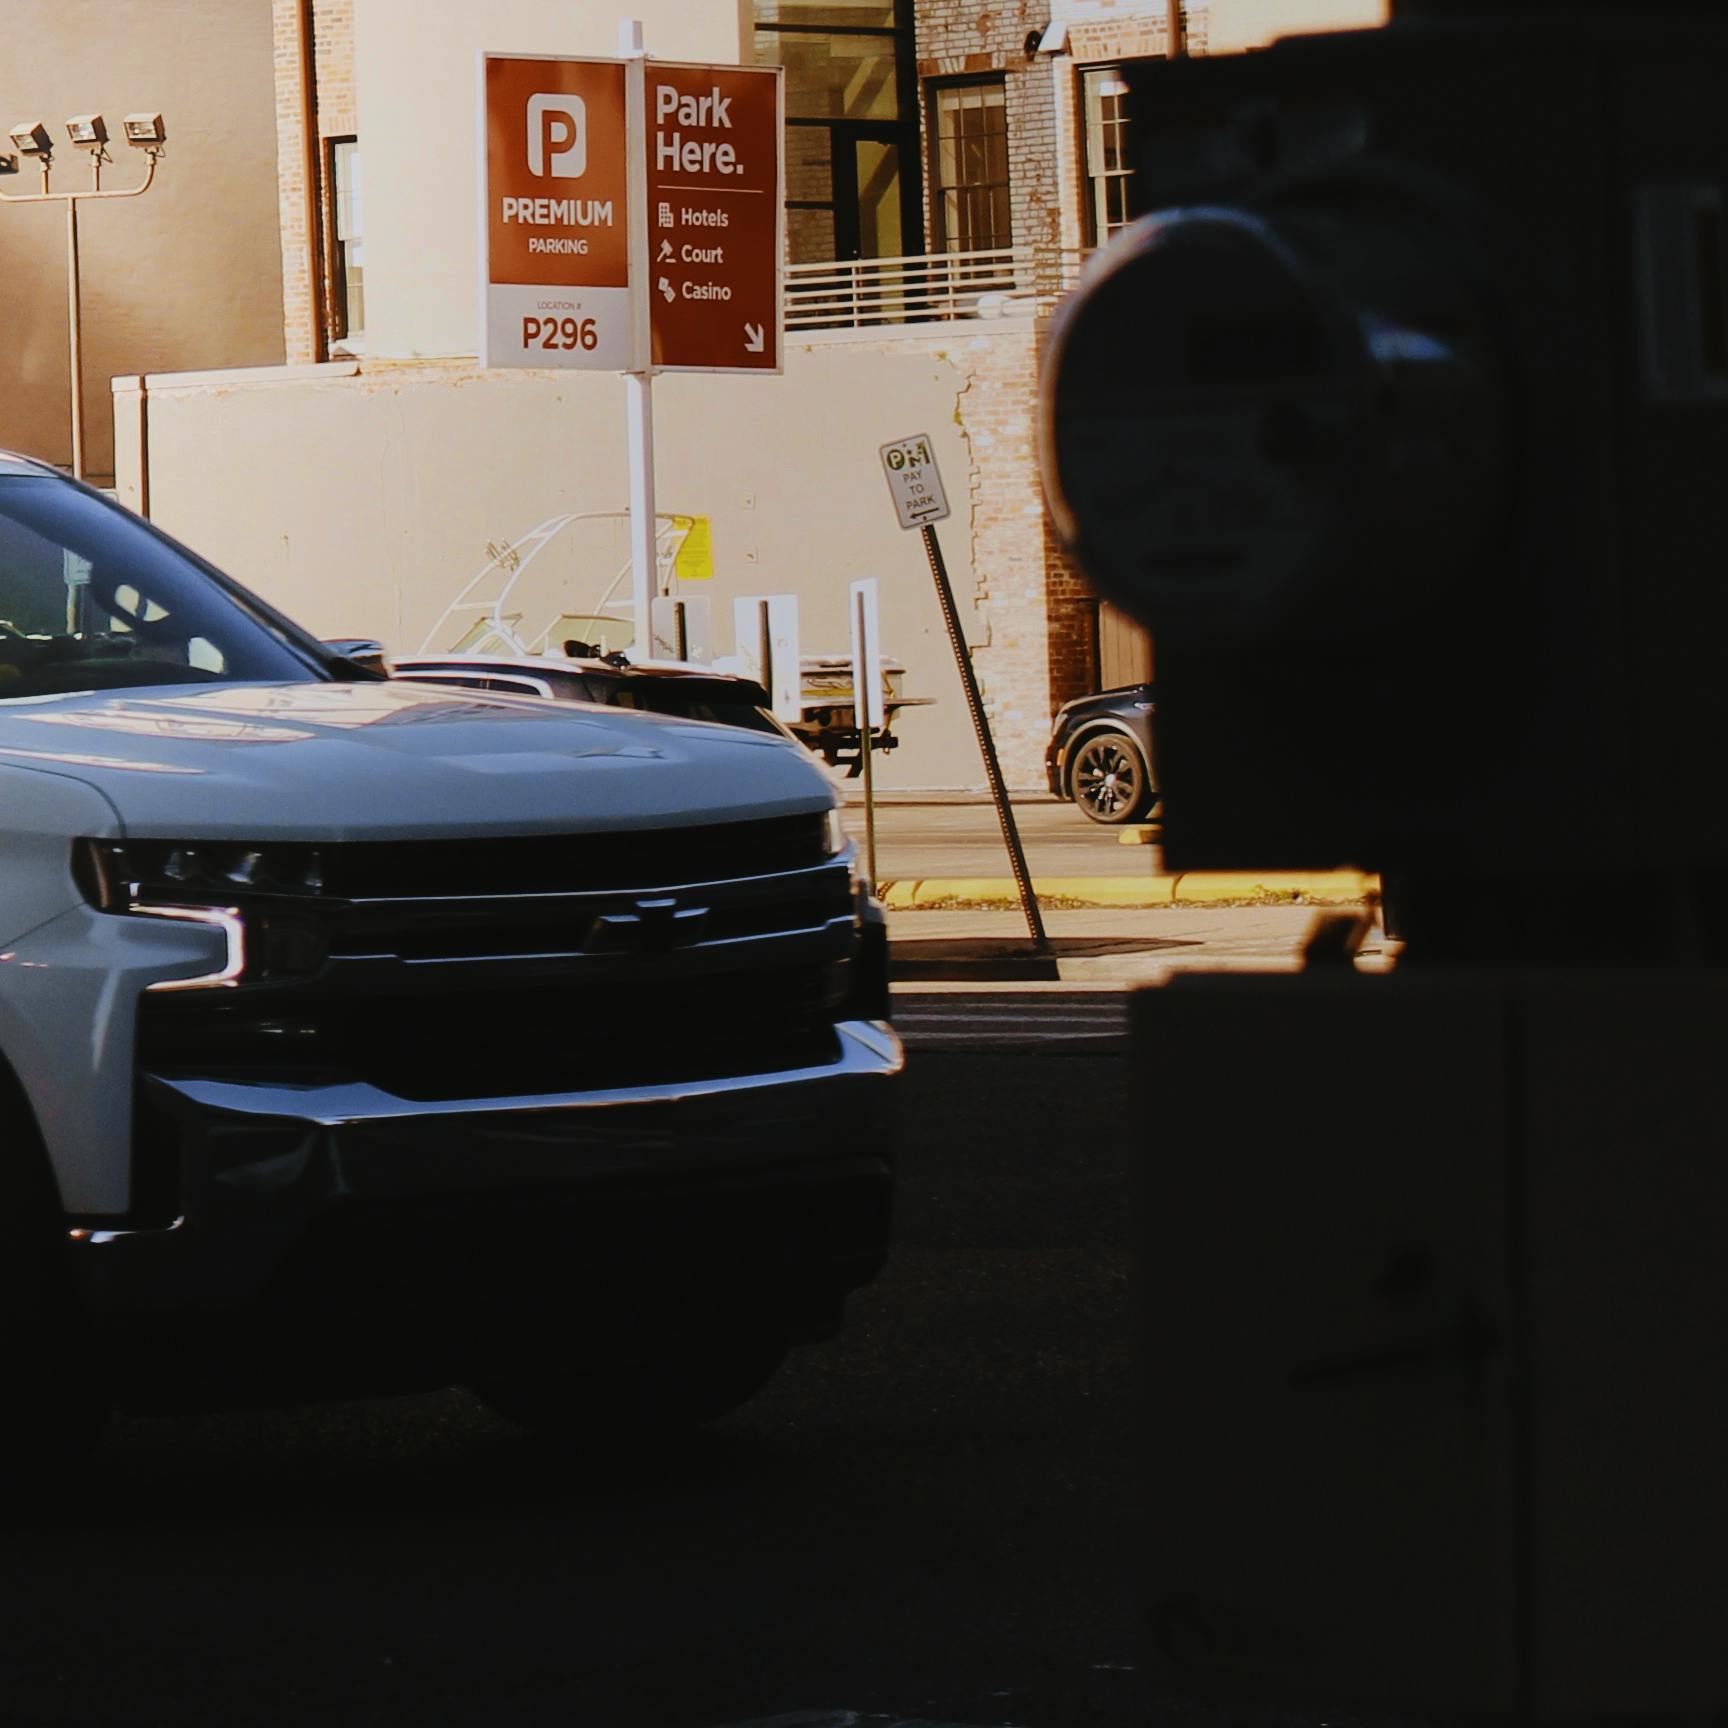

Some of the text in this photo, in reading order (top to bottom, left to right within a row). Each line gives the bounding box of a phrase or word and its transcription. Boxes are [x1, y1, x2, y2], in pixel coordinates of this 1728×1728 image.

[656, 84, 733, 129] Park
[656, 131, 744, 175] Here.
[502, 197, 613, 226] PREMIUM
[681, 208, 729, 228] Hotels
[528, 238, 588, 255] PARKING
[681, 244, 724, 264] Court
[681, 282, 732, 301] Casino
[537, 301, 575, 310] LOCATION
[522, 317, 598, 351] P296
[903, 471, 922, 483] PAY
[909, 483, 924, 495] TO
[906, 495, 935, 510] PARK
